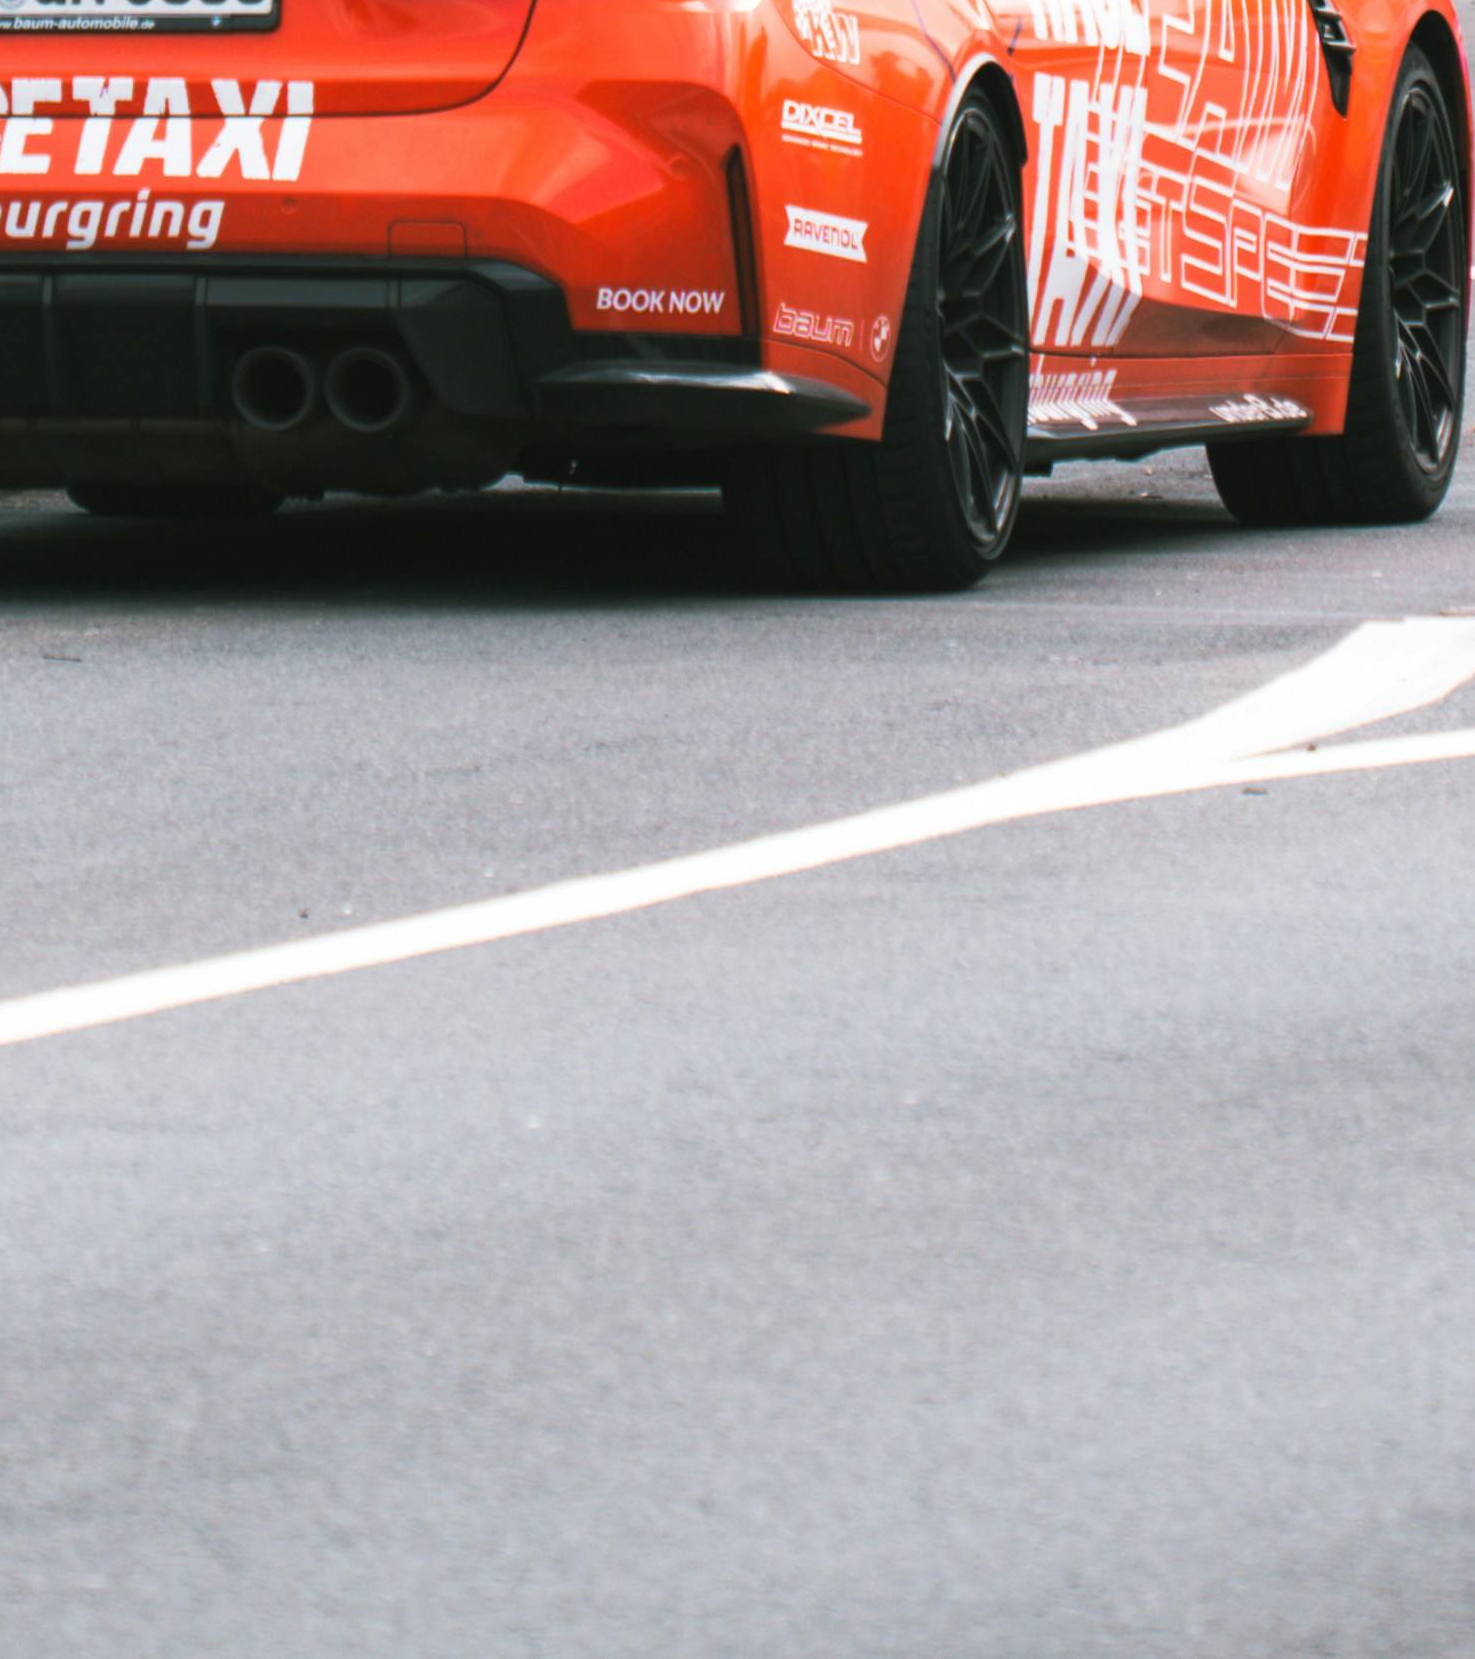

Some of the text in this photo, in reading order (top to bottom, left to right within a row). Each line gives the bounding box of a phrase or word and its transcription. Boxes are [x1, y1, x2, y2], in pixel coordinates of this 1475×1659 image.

[781, 99, 862, 136] DIXCEL
[794, 218, 858, 250] RAVENOL
[596, 287, 725, 314] BOOK NOW
[773, 302, 854, 347] baum
